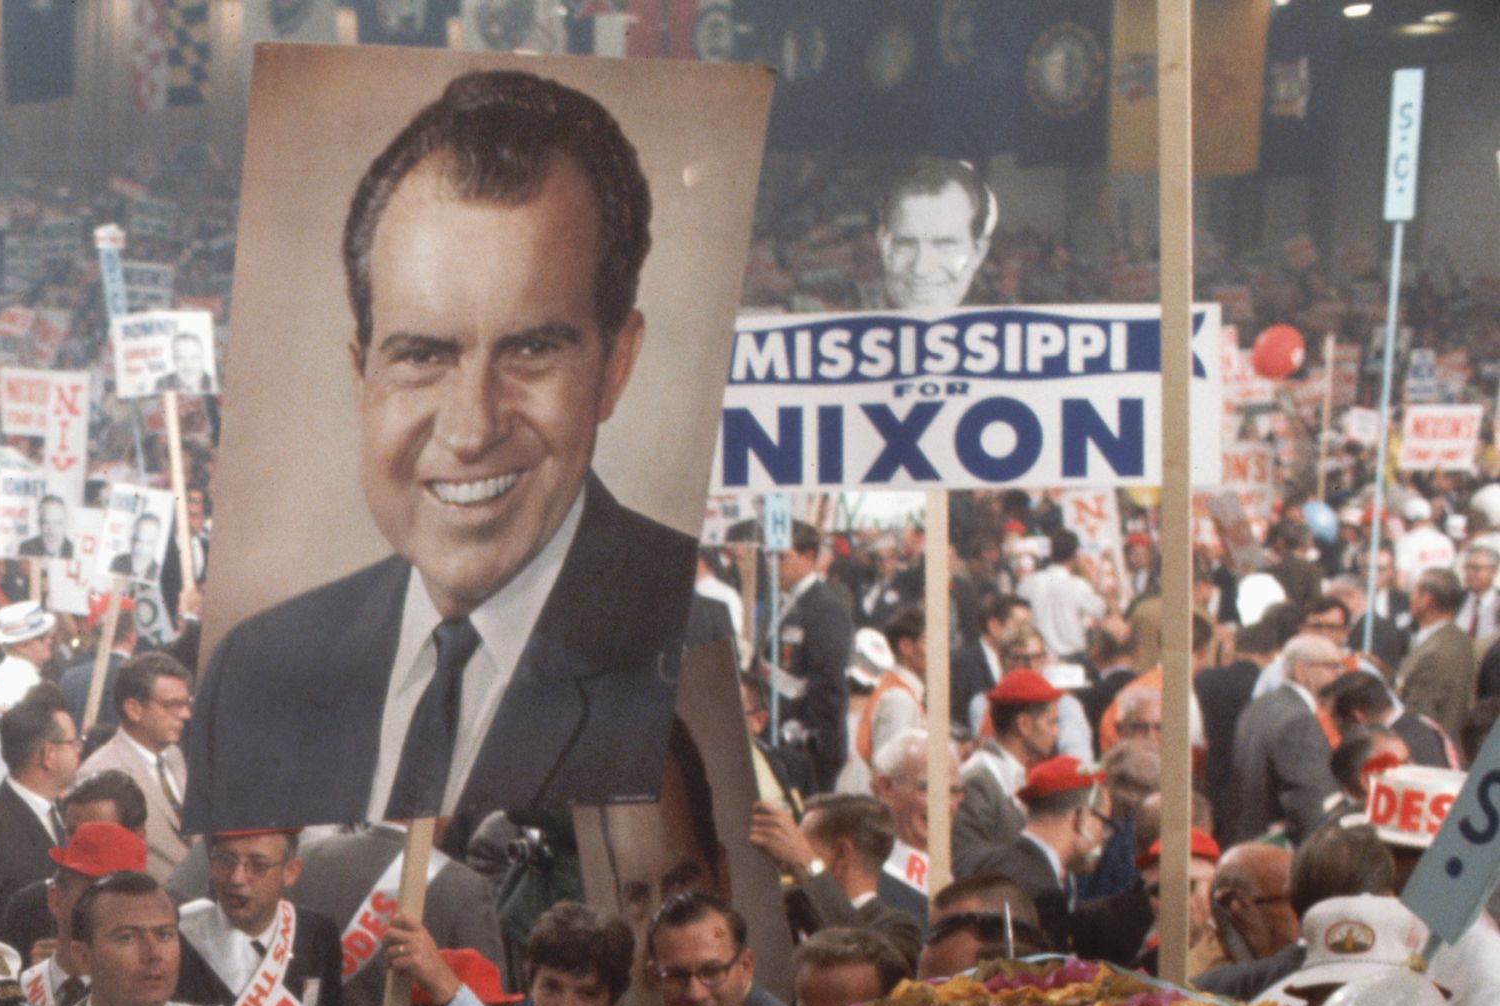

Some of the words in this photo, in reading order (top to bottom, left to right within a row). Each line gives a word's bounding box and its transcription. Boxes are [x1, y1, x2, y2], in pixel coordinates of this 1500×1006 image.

[1393, 102, 1414, 194] S.C.
[731, 322, 1128, 380] MISSISSIPPI
[894, 381, 971, 397] FOR
[722, 396, 1145, 486] NIXON
